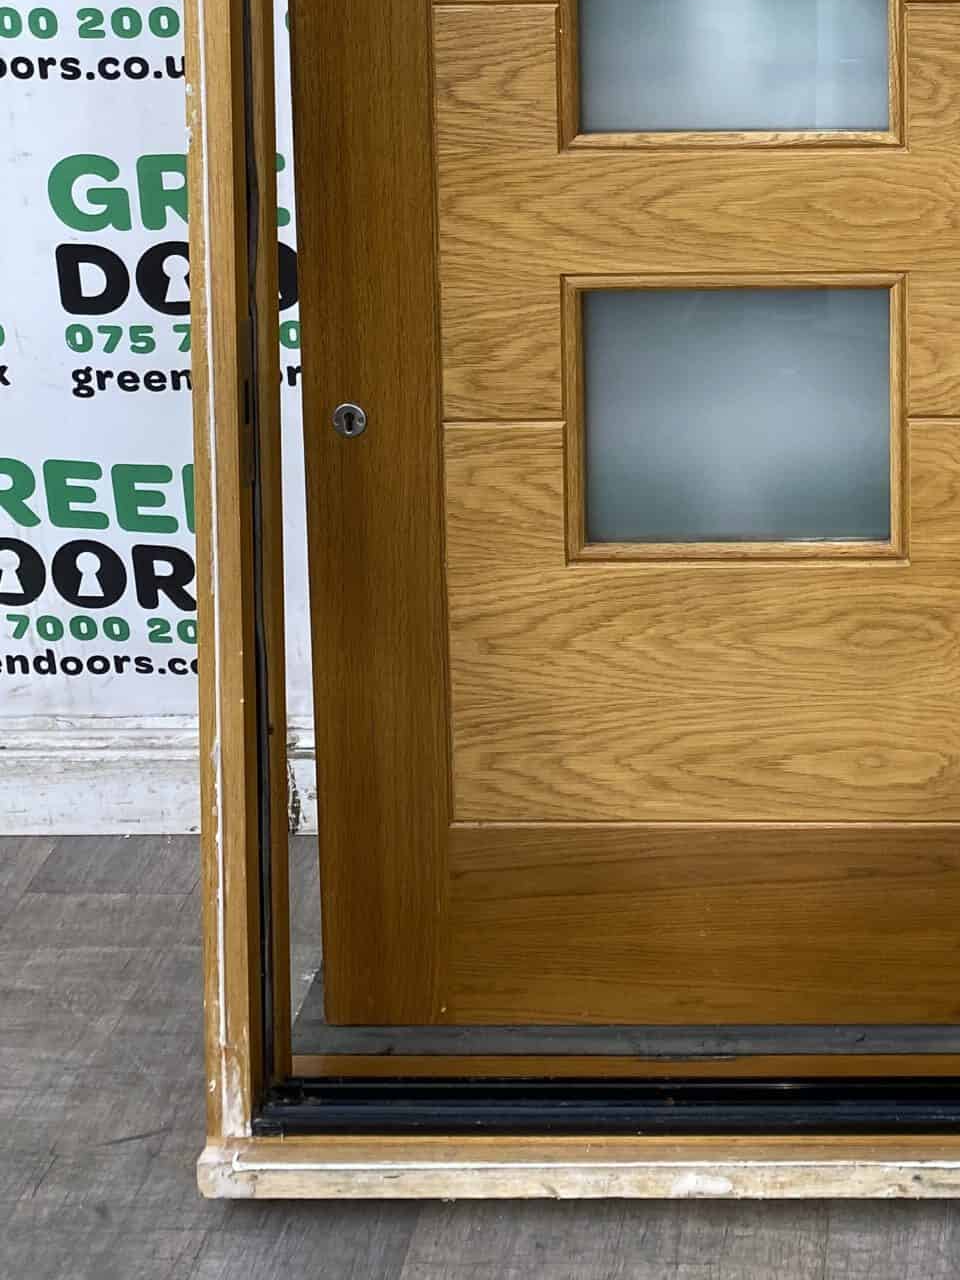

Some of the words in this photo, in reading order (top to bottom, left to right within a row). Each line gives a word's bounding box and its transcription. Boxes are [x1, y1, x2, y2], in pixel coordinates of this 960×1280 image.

[76, 6, 181, 40] 200
[0, 55, 185, 81] ors.co.u
[66, 323, 156, 354] 075
[0, 457, 195, 534] REE
[6, 614, 130, 642] 7000
[0, 649, 198, 676] ndoors.c
